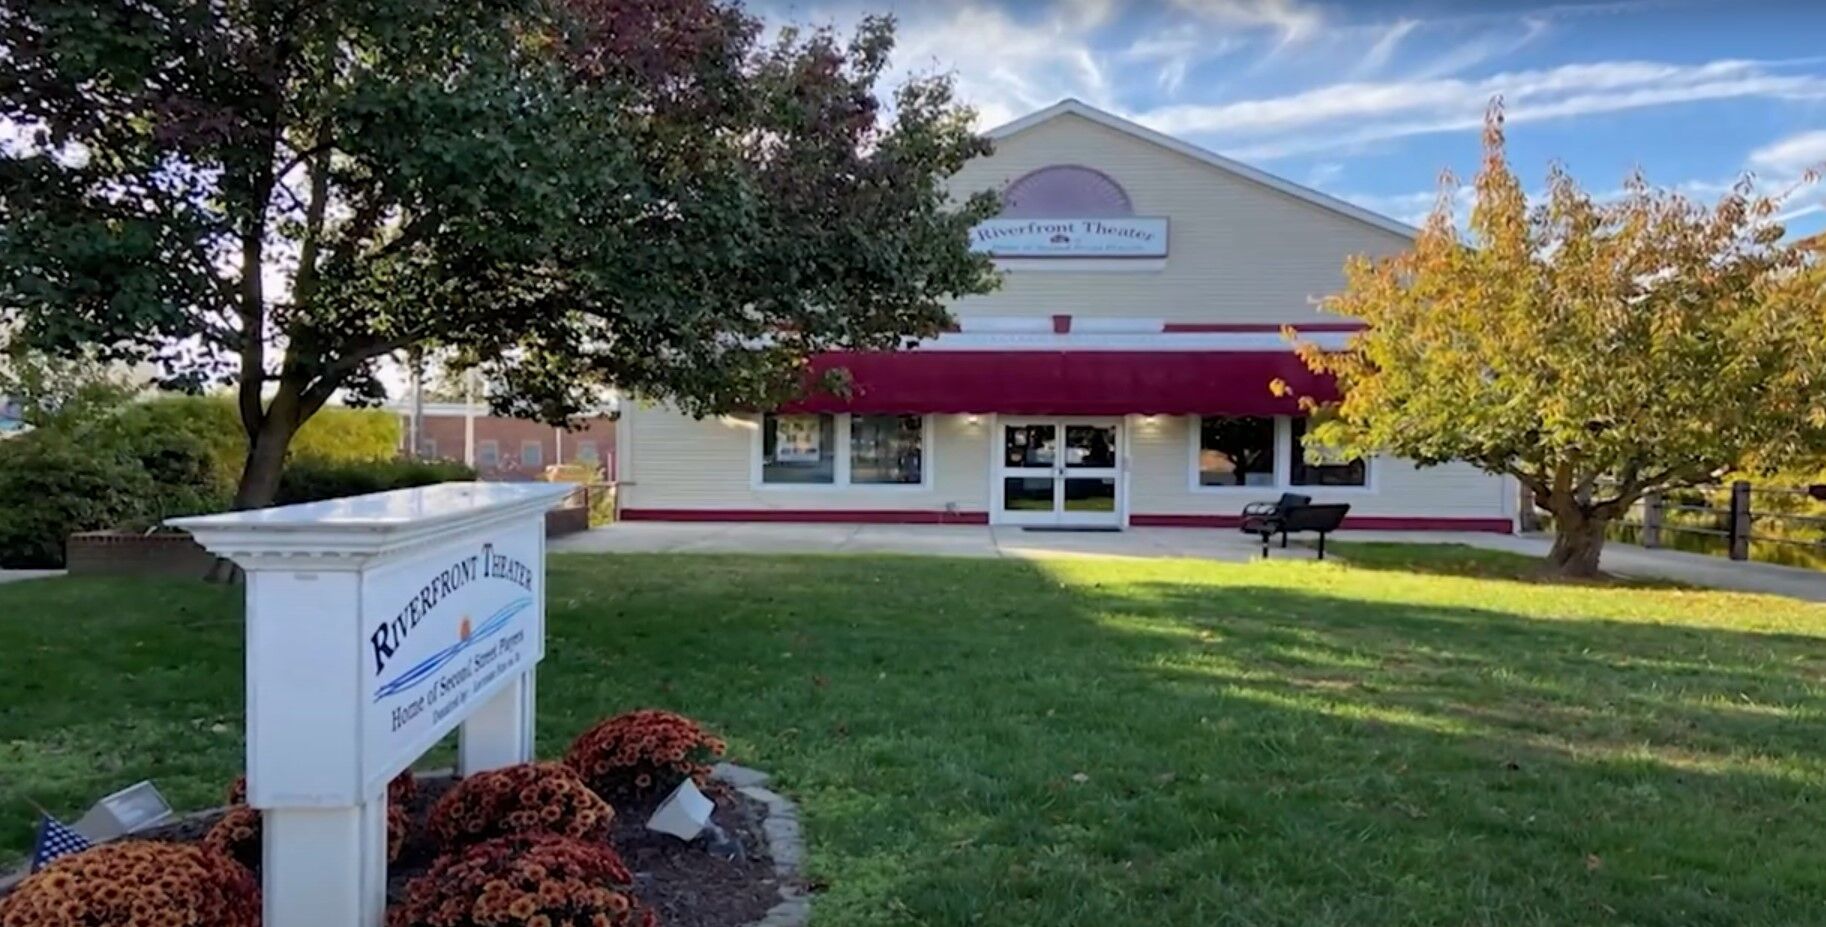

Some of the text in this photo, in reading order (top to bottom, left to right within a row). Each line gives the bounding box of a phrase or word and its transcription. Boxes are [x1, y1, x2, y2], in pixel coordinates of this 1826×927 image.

[977, 221, 1156, 242] Riverfront Theater
[370, 556, 478, 676] RIVERFRONT
[481, 543, 532, 592] THEATER
[391, 696, 424, 732] Home
[427, 682, 438, 706] of
